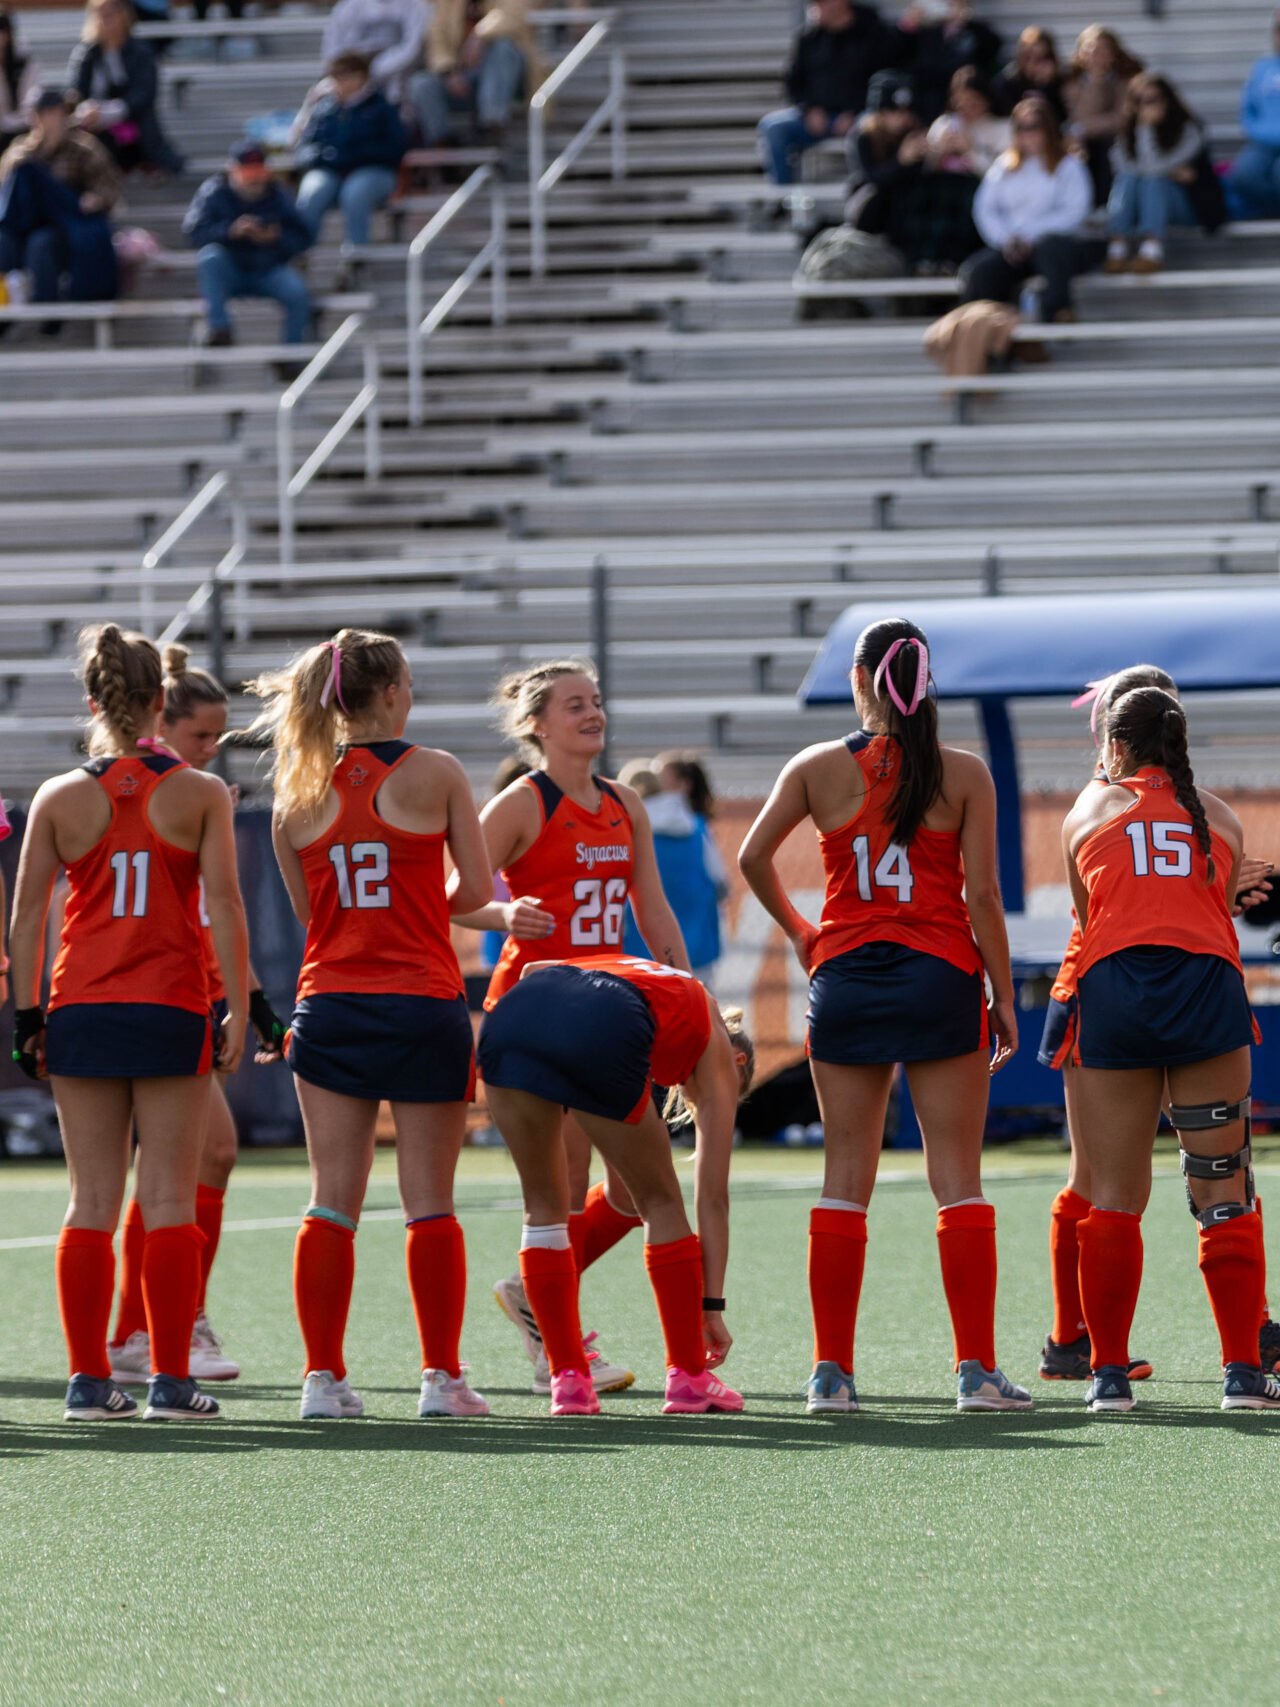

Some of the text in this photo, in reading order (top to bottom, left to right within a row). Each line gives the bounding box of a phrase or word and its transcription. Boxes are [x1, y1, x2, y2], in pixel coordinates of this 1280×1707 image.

[328, 841, 392, 910] 12
[575, 841, 630, 870] Syracuse
[851, 834, 914, 904] 14
[1124, 821, 1194, 878] 15
[110, 850, 150, 918] 11
[570, 878, 627, 946] 26
